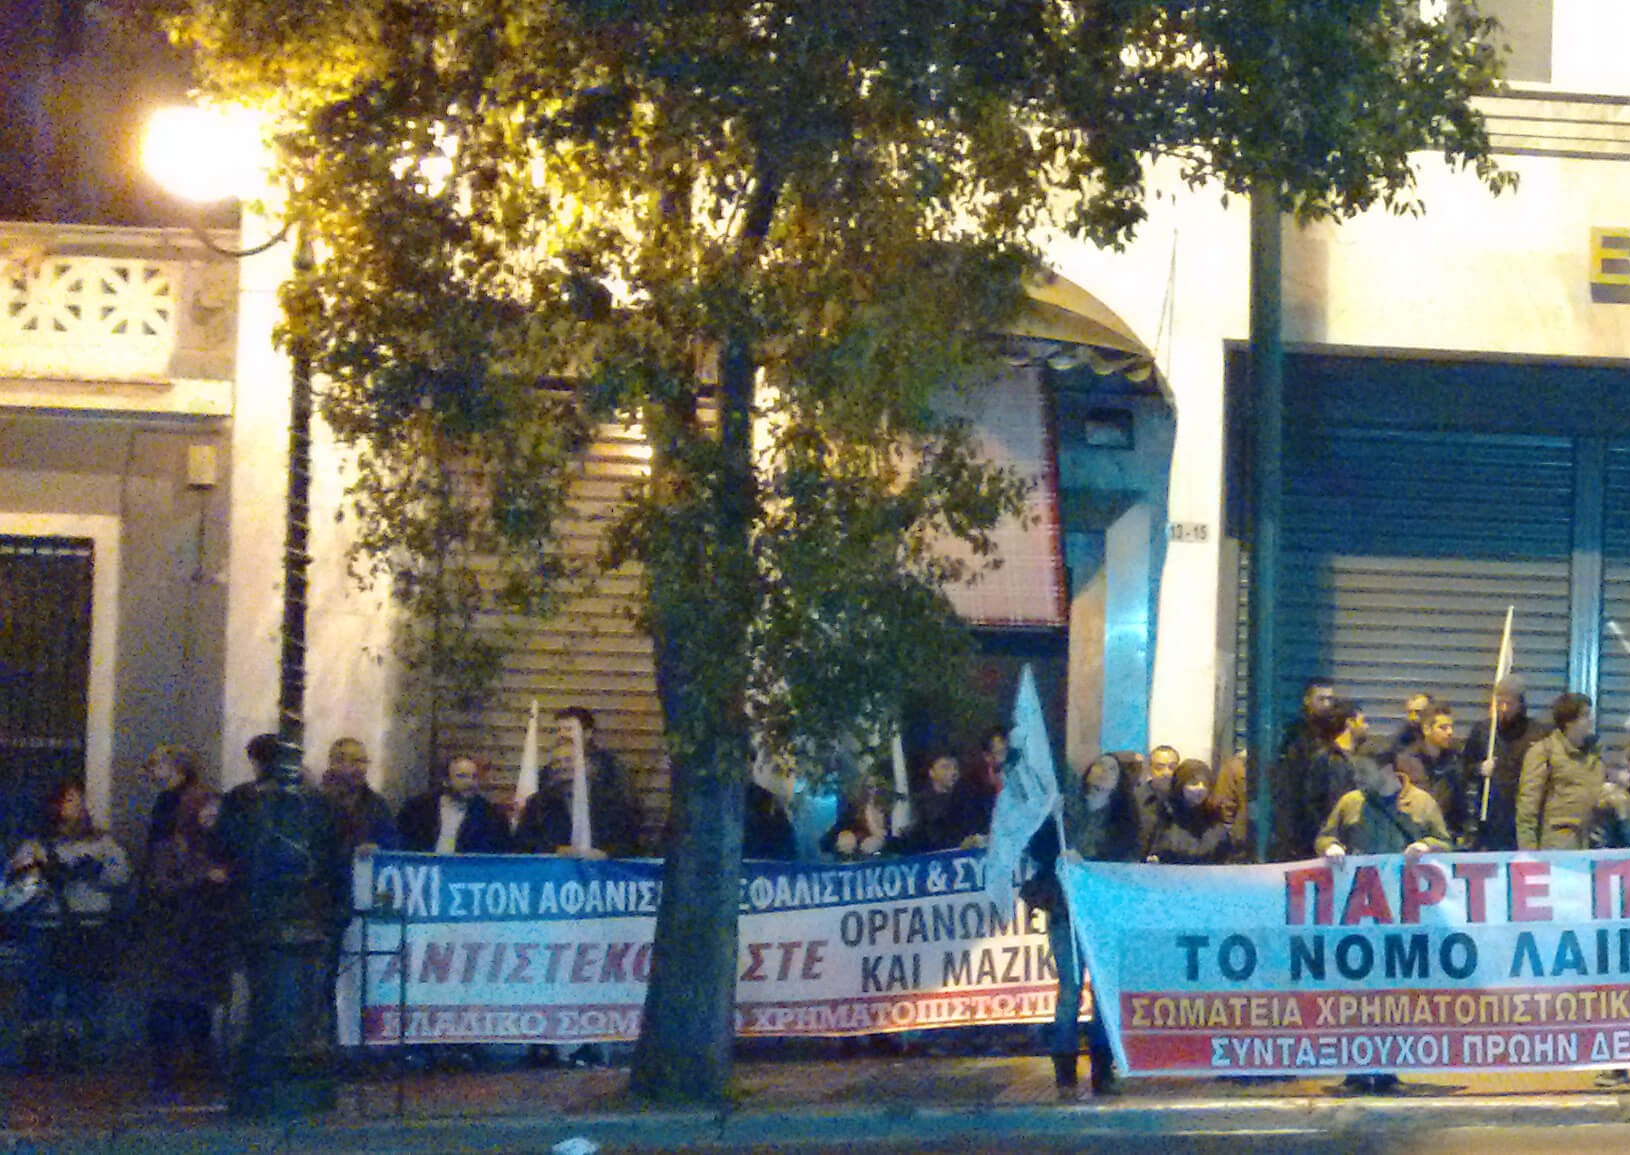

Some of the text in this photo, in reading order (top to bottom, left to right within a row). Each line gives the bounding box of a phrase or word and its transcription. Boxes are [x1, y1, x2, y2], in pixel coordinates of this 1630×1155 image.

[448, 882, 531, 916] ΣΤΟΝ
[538, 879, 663, 916] ΑΦΑΝΙΣ
[926, 860, 946, 892] &
[1285, 860, 1554, 926] ΠΑΡΤΕ
[861, 952, 921, 993] ΚΑΙ
[1175, 933, 1258, 982] ΤΟ
[1289, 931, 1479, 981] ΝΟΜΟ
[1131, 996, 1303, 1028] ΣΩΜΑΤΕΙΑ
[1210, 1033, 1449, 1068] ΣΥΝΤΑΞΙΟΥΧΟΙ
[1463, 1030, 1578, 1064] ΠΡΩΗΝ
